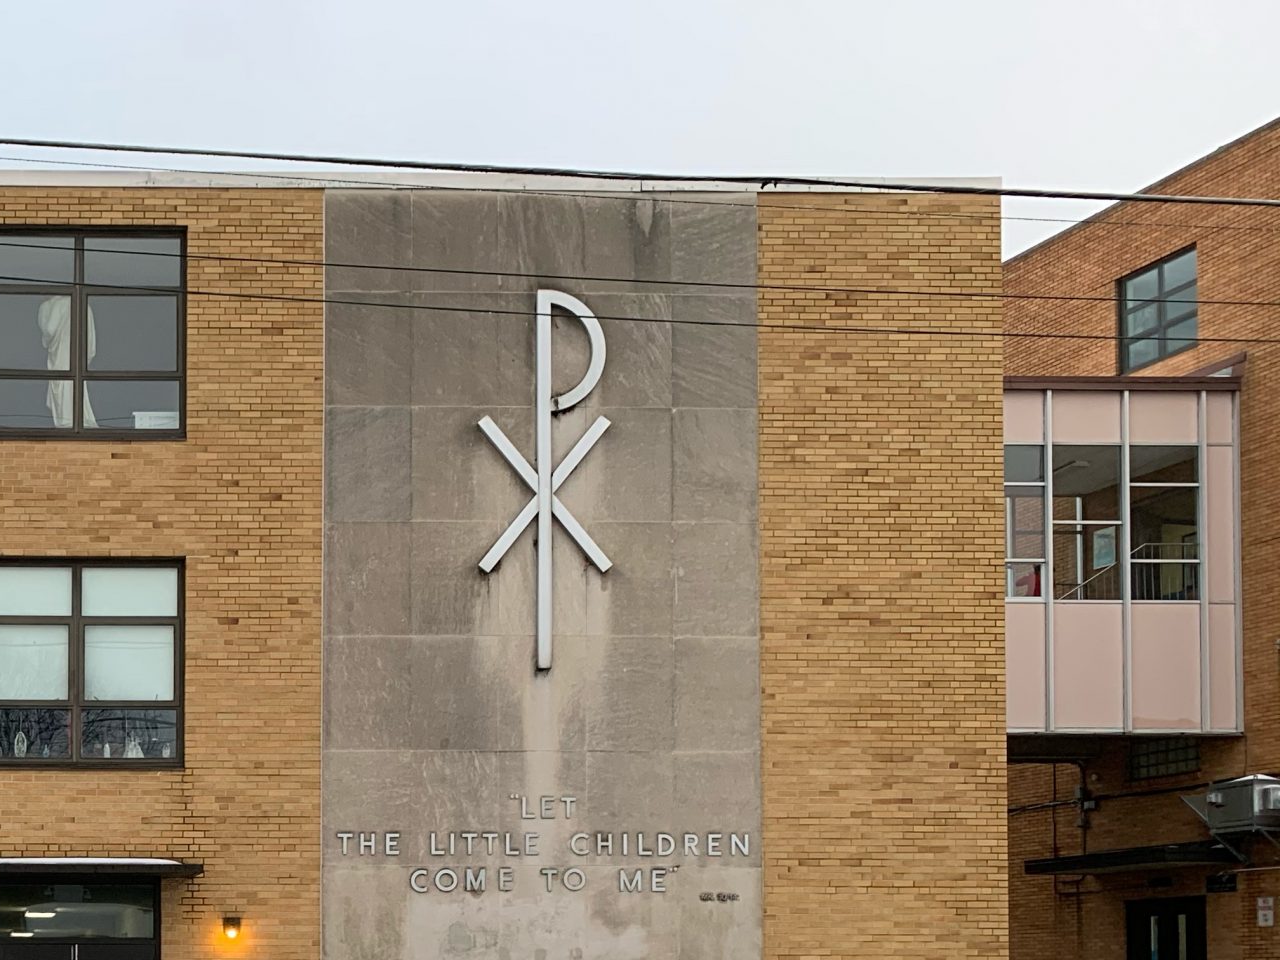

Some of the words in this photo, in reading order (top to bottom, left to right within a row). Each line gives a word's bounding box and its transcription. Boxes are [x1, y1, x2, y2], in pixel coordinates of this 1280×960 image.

[336, 832, 401, 856] THE
[430, 832, 540, 856] LITTLE
[570, 832, 750, 857] CHILDREN
[410, 867, 513, 893] COME
[540, 867, 587, 893] TO
